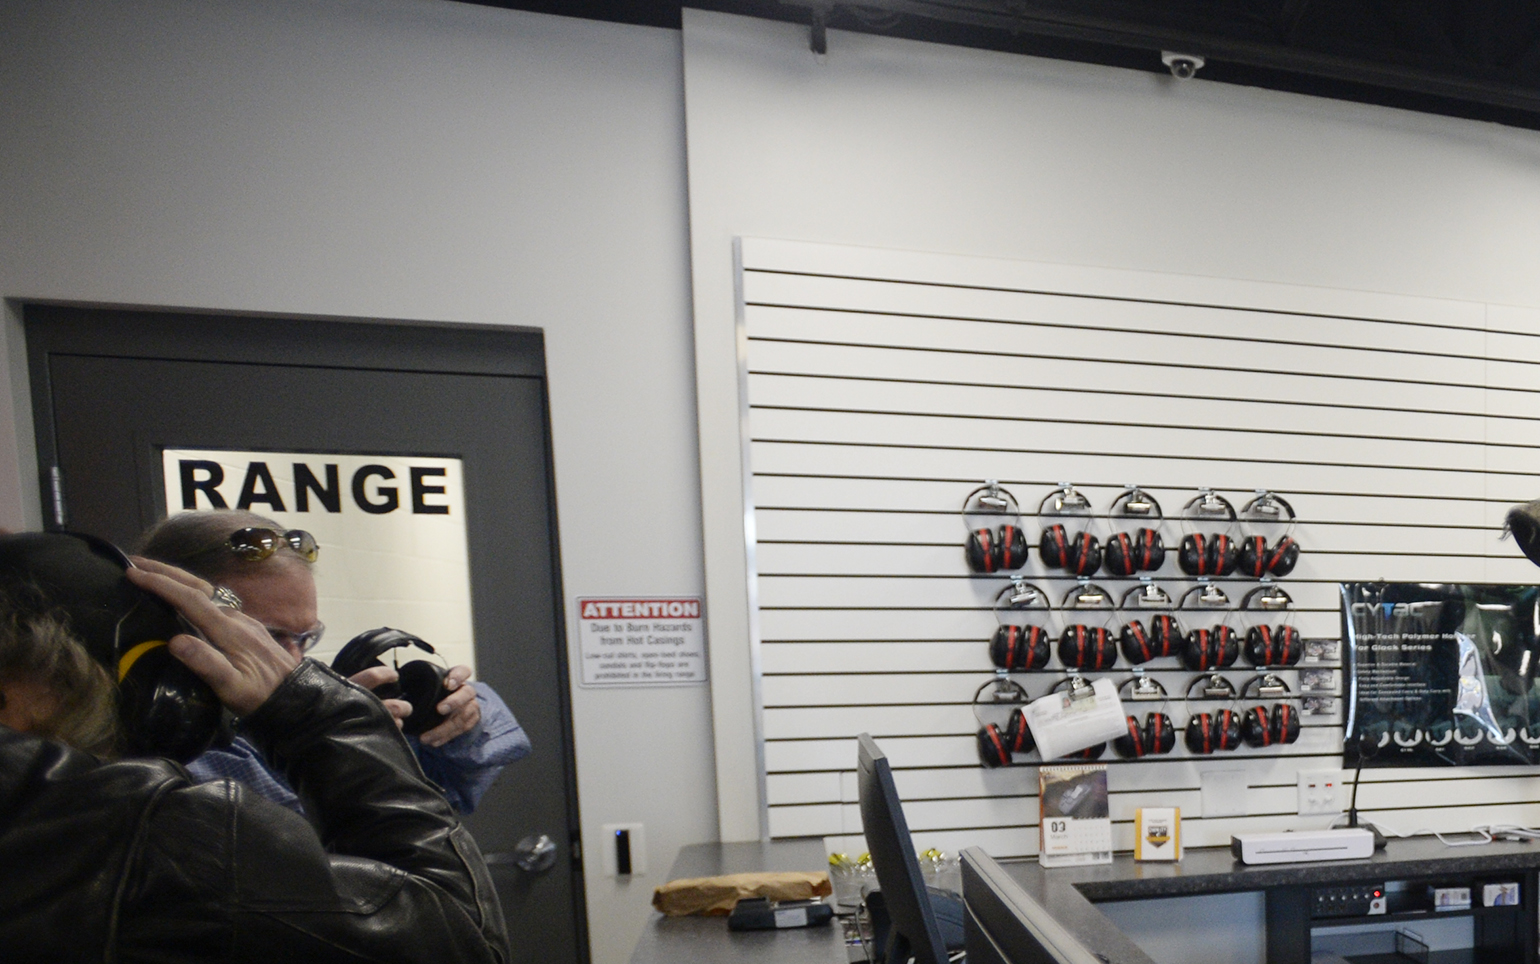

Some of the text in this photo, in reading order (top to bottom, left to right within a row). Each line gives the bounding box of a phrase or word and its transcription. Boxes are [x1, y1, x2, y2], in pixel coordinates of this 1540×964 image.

[179, 459, 450, 515] RANGE
[583, 602, 699, 618] ATTENTION
[591, 623, 692, 633] Due to Burn Hazards
[600, 635, 684, 647] from Hot Casings
[1402, 632, 1440, 641] Polymer
[1371, 643, 1399, 652] Glock
[1401, 643, 1433, 652] Series
